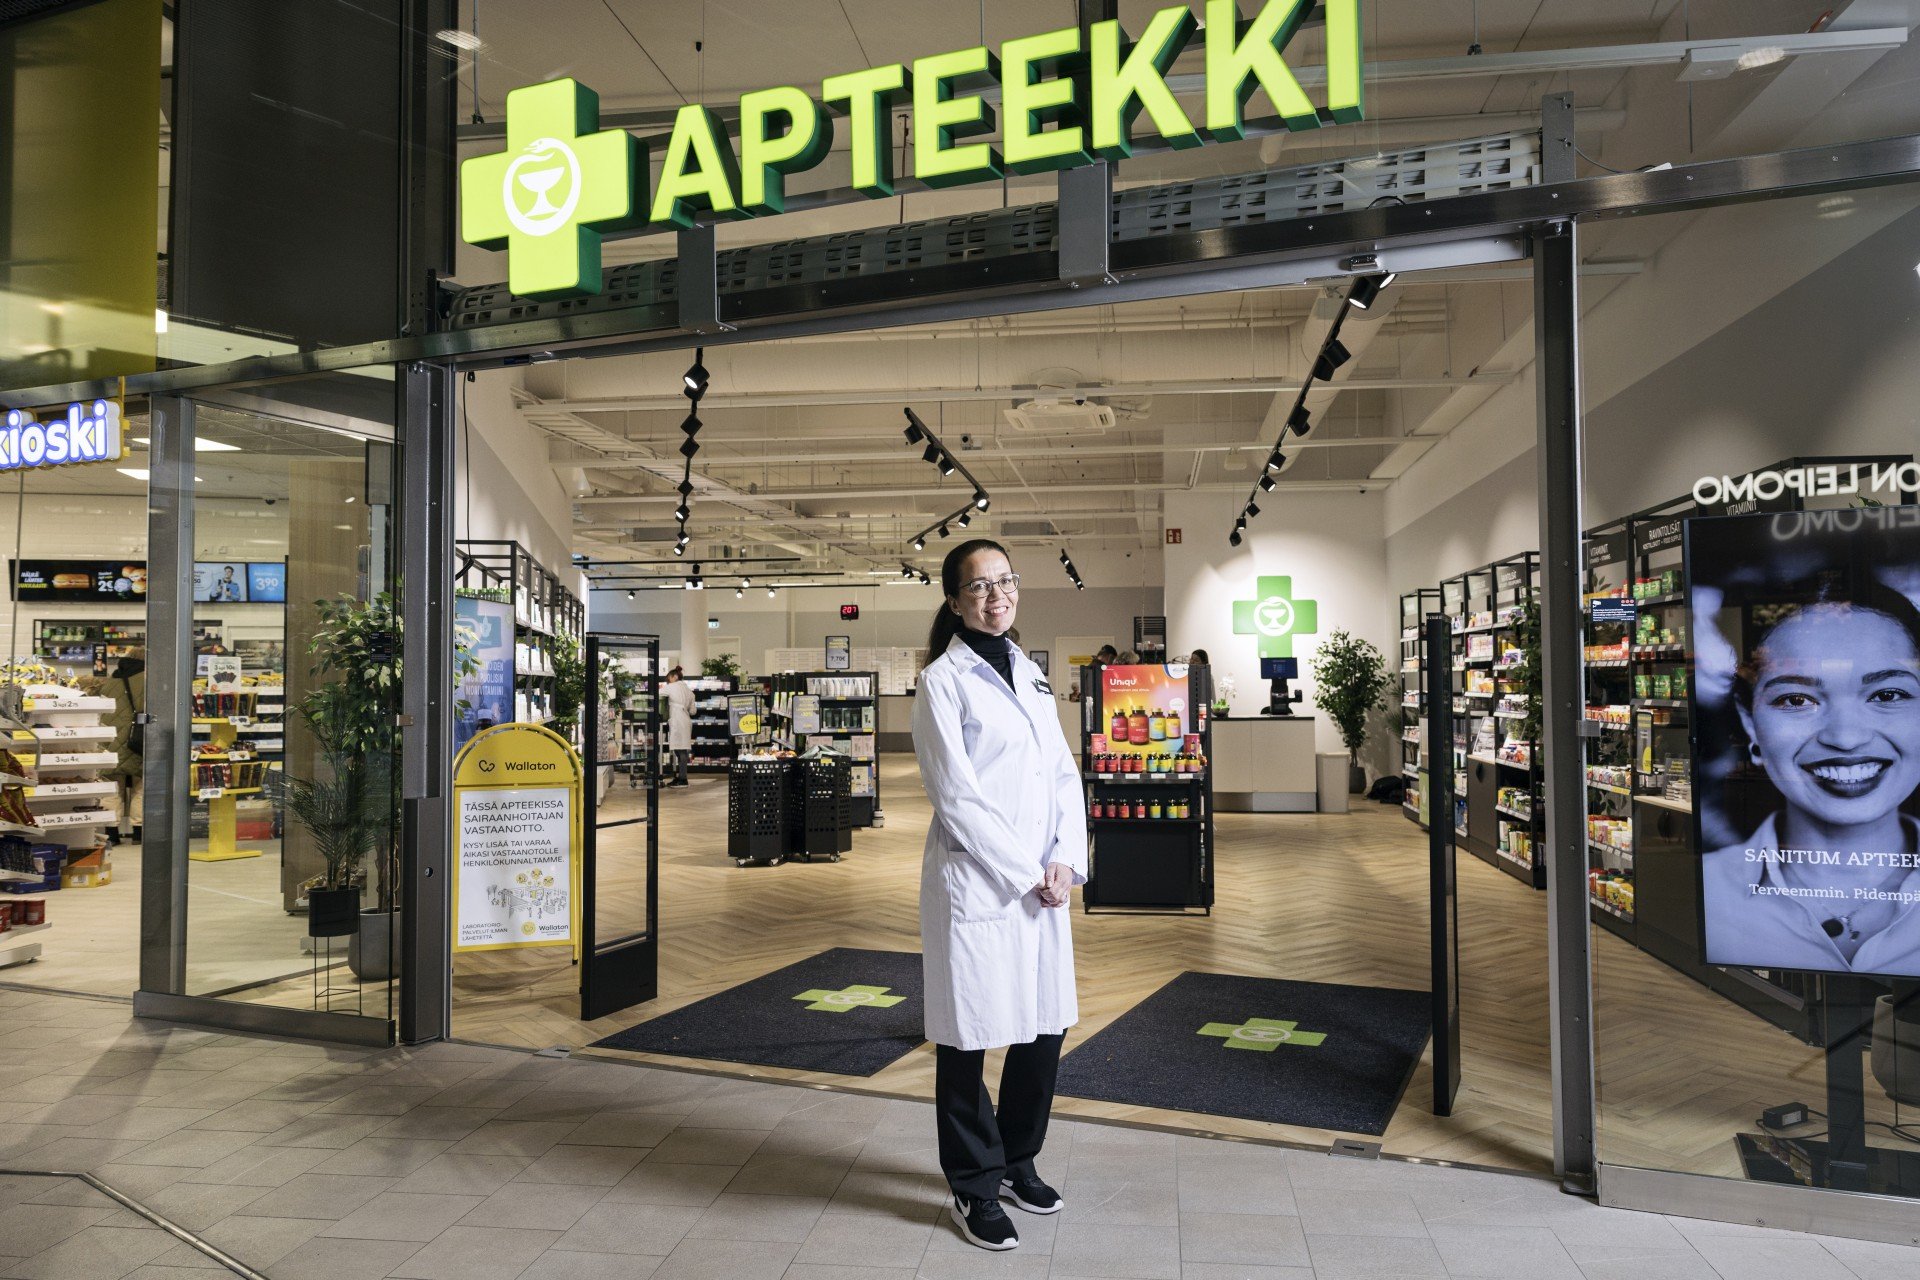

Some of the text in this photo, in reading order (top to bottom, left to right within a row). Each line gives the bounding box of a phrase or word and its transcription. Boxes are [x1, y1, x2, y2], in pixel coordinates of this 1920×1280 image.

[650, 0, 1364, 222] APTEEKKI
[505, 762, 556, 770] Wallaton
[465, 800, 564, 811] TÄSSÄ APTEEKISSA
[464, 812, 564, 823] SAIRAANHOITAJAN
[464, 824, 544, 834] VASTAANOTTO.
[491, 847, 559, 857] VASTAANOTOLLE
[1744, 848, 1840, 865] SANITUM
[463, 856, 564, 867] HENKILÖKUNNALTAMME.
[1748, 883, 1920, 904] Terveemmin. Pidempä
